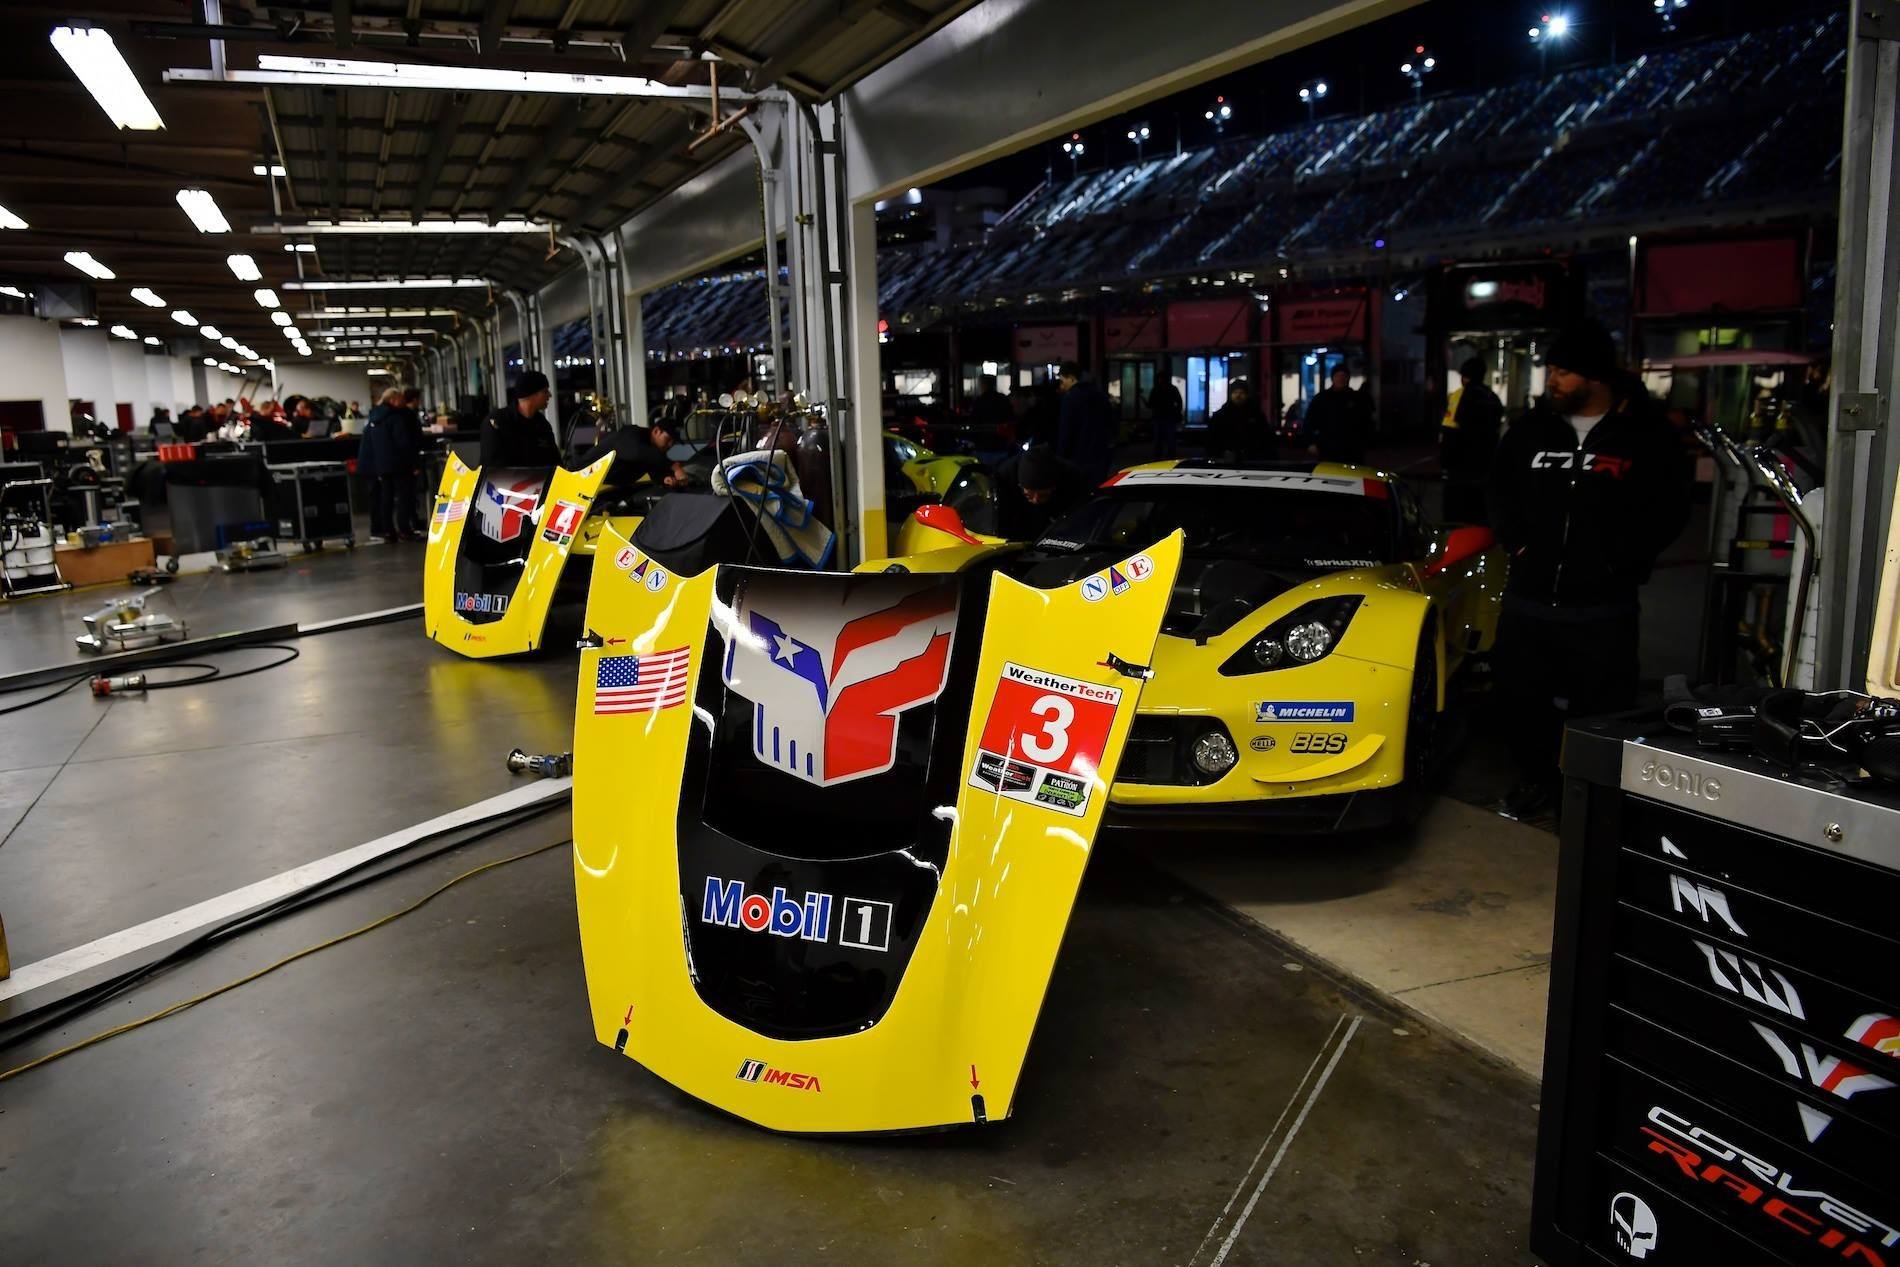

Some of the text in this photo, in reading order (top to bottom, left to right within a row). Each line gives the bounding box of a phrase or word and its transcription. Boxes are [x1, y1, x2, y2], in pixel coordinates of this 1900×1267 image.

[1128, 472, 1357, 487] CORVETTE
[619, 550, 634, 566] E
[1130, 558, 1149, 577] E
[648, 572, 664, 588] N
[1086, 579, 1102, 597] N
[1114, 582, 1128, 593] OFF
[455, 592, 491, 612] Mobil
[1009, 666, 1117, 701] WeatherTech
[1279, 708, 1346, 718] MICHELIN
[1021, 694, 1075, 764] 3
[1290, 732, 1348, 754] BBS
[702, 876, 833, 943] Mobil
[763, 1068, 821, 1093] IMSA
